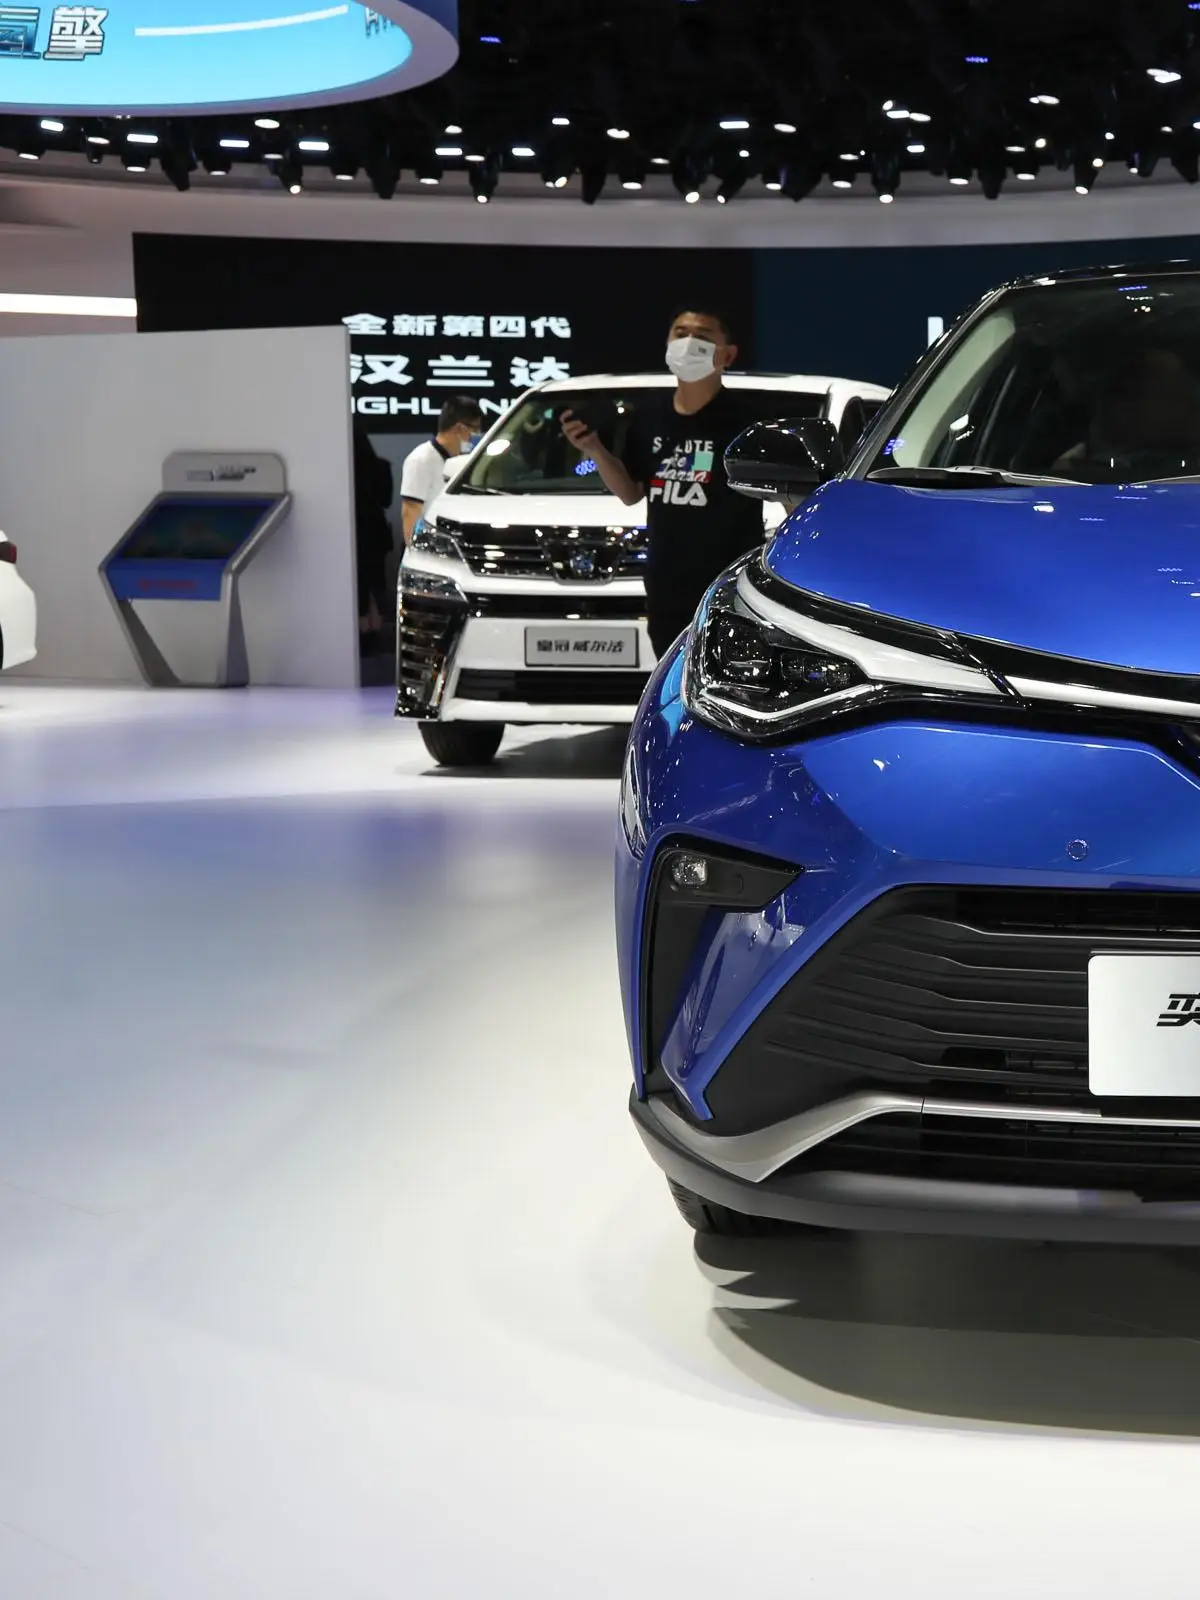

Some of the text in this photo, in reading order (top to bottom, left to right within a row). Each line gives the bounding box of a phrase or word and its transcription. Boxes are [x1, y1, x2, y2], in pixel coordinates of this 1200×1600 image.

[341, 313, 571, 338] 全新第四代
[350, 354, 570, 387] 汉兰达
[649, 479, 708, 506] FILA
